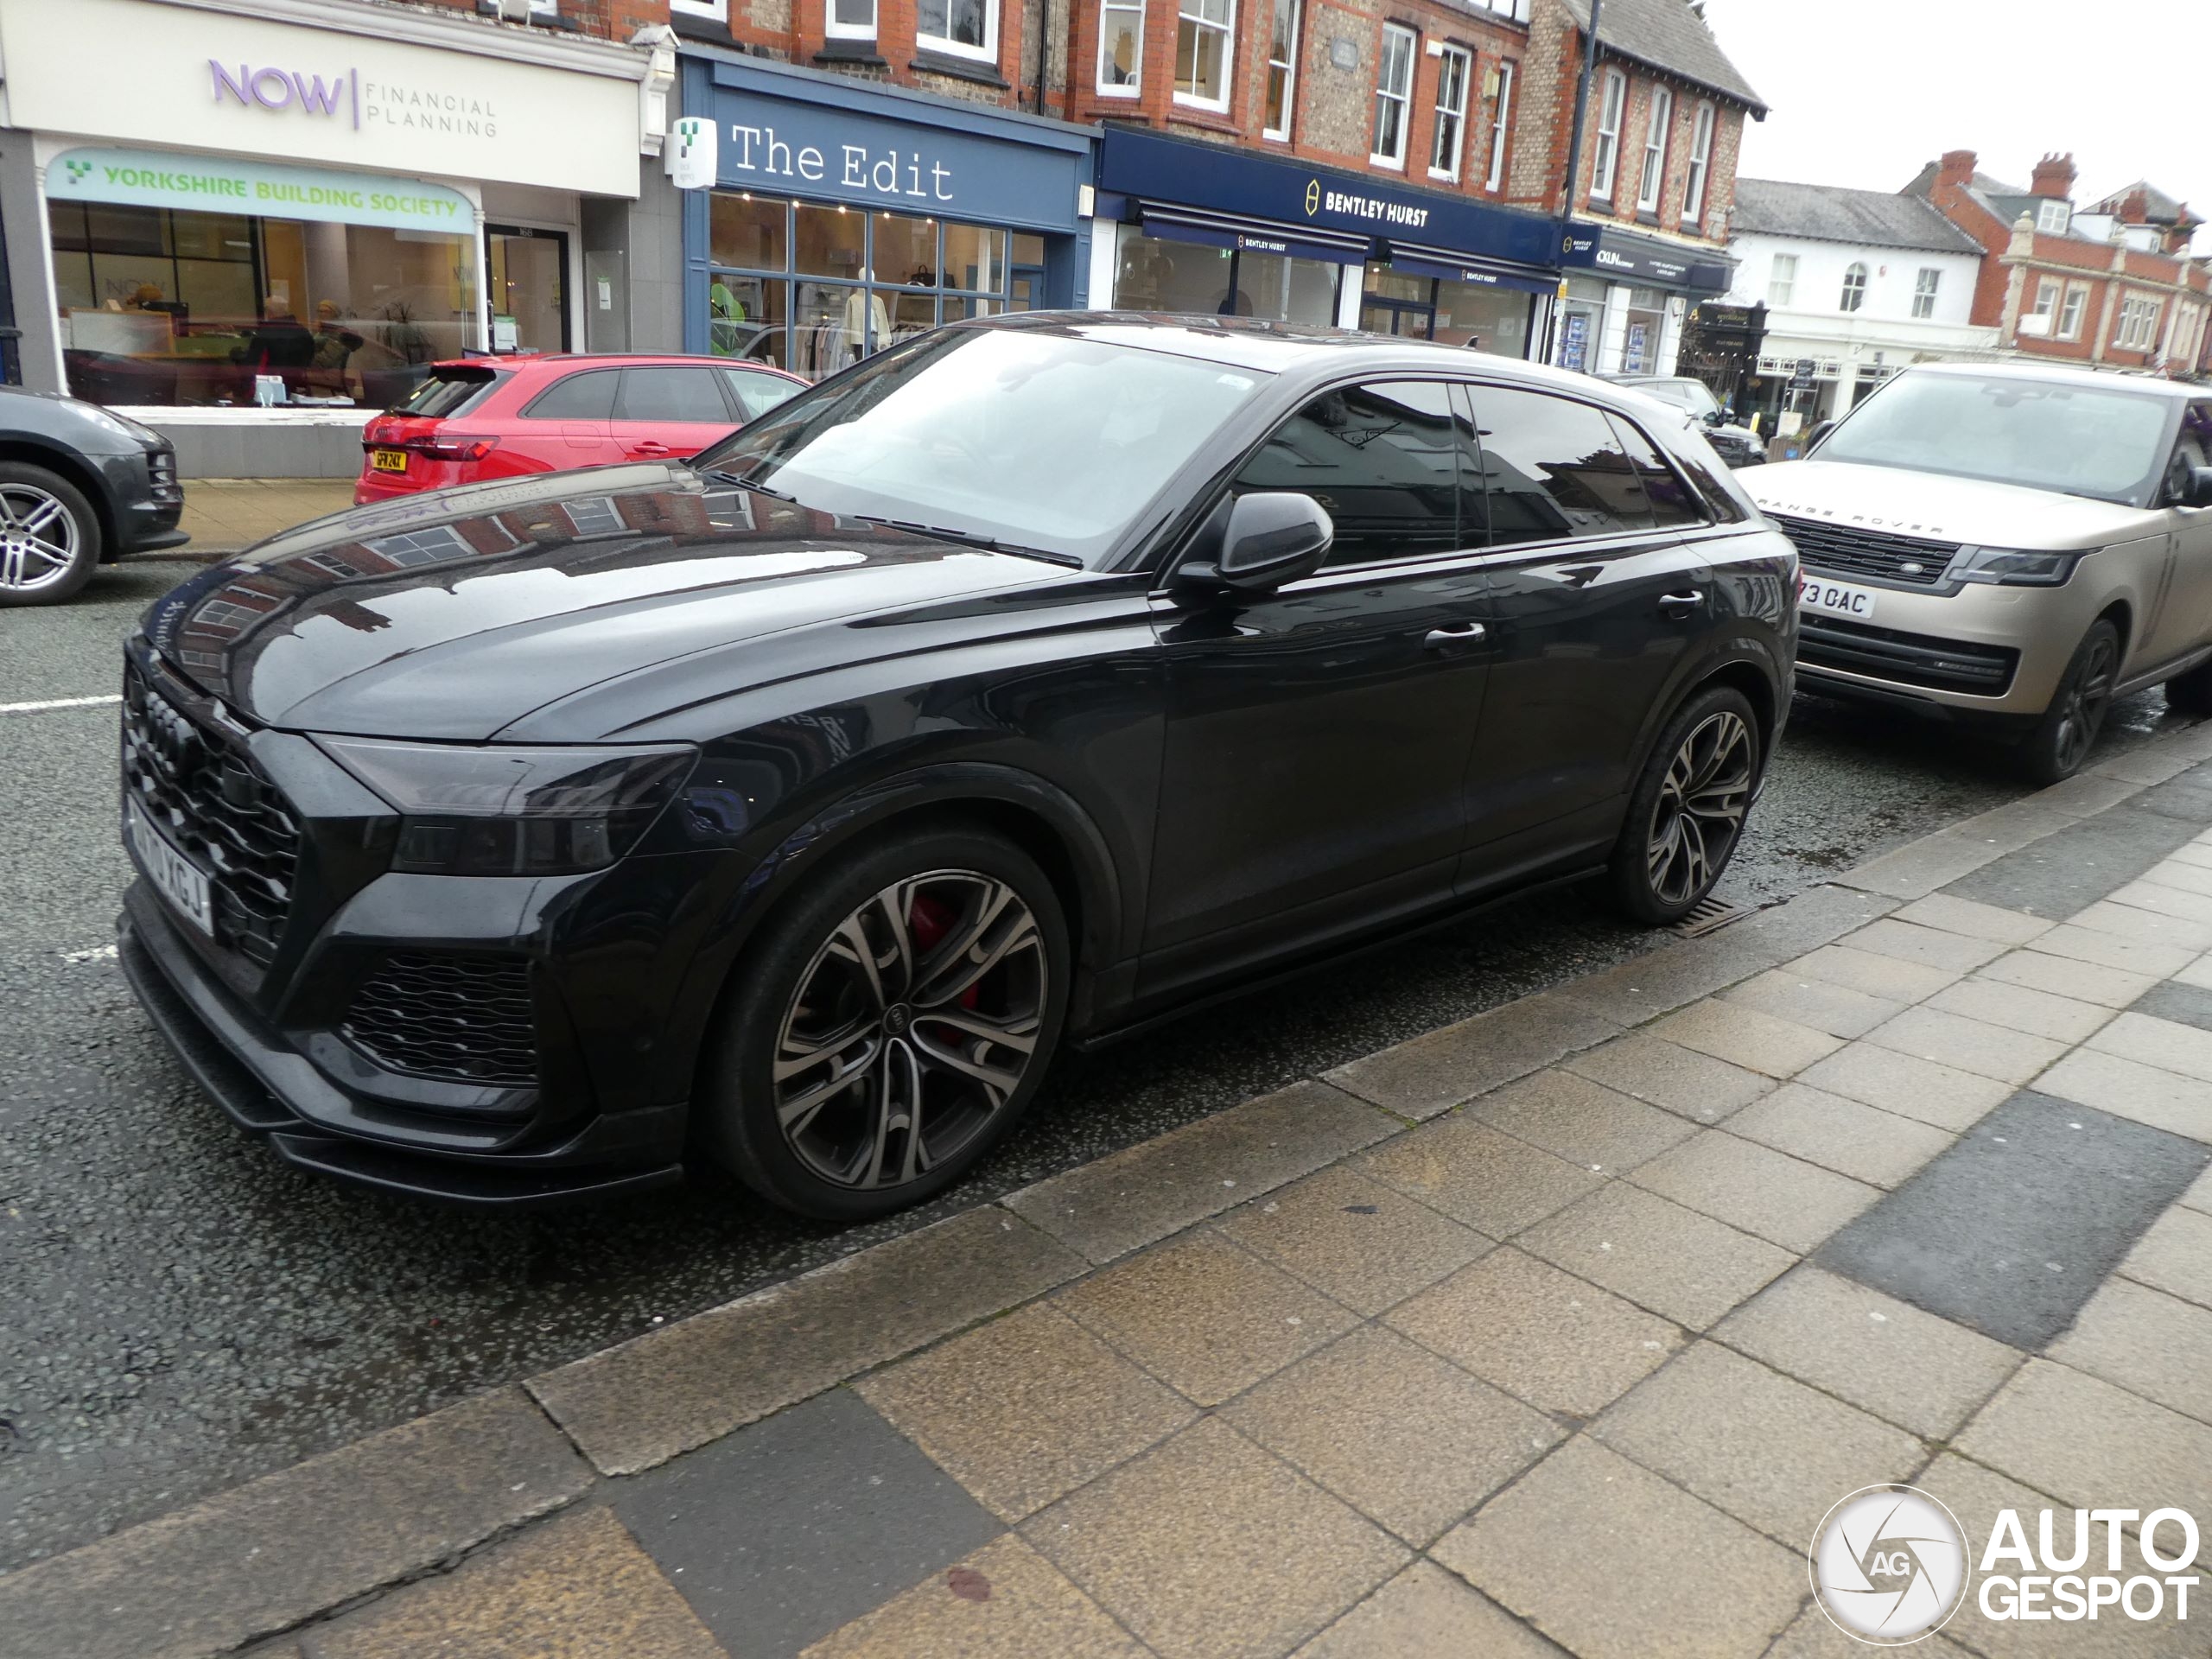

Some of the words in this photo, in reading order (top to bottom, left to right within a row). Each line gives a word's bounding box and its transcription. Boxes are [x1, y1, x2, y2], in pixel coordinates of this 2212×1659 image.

[207, 59, 344, 116] NOW
[365, 83, 497, 118] FINANCIAL
[367, 105, 498, 138] PLANNING
[733, 124, 824, 181] The
[841, 144, 953, 200] Edit
[104, 166, 248, 198] YORKSHIRE
[255, 181, 364, 209] BUILDING
[371, 194, 458, 218] SOCIETY
[1325, 191, 1386, 220] BENTLEY
[1386, 202, 1428, 228] HURST
[519, 227, 533, 238] 168
[1245, 238, 1269, 250] BENTLEY
[1268, 242, 1286, 252] HURST
[1466, 271, 1484, 282] BENTLEY
[1757, 498, 1834, 517] RANGE
[1852, 515, 1943, 534] ROVER
